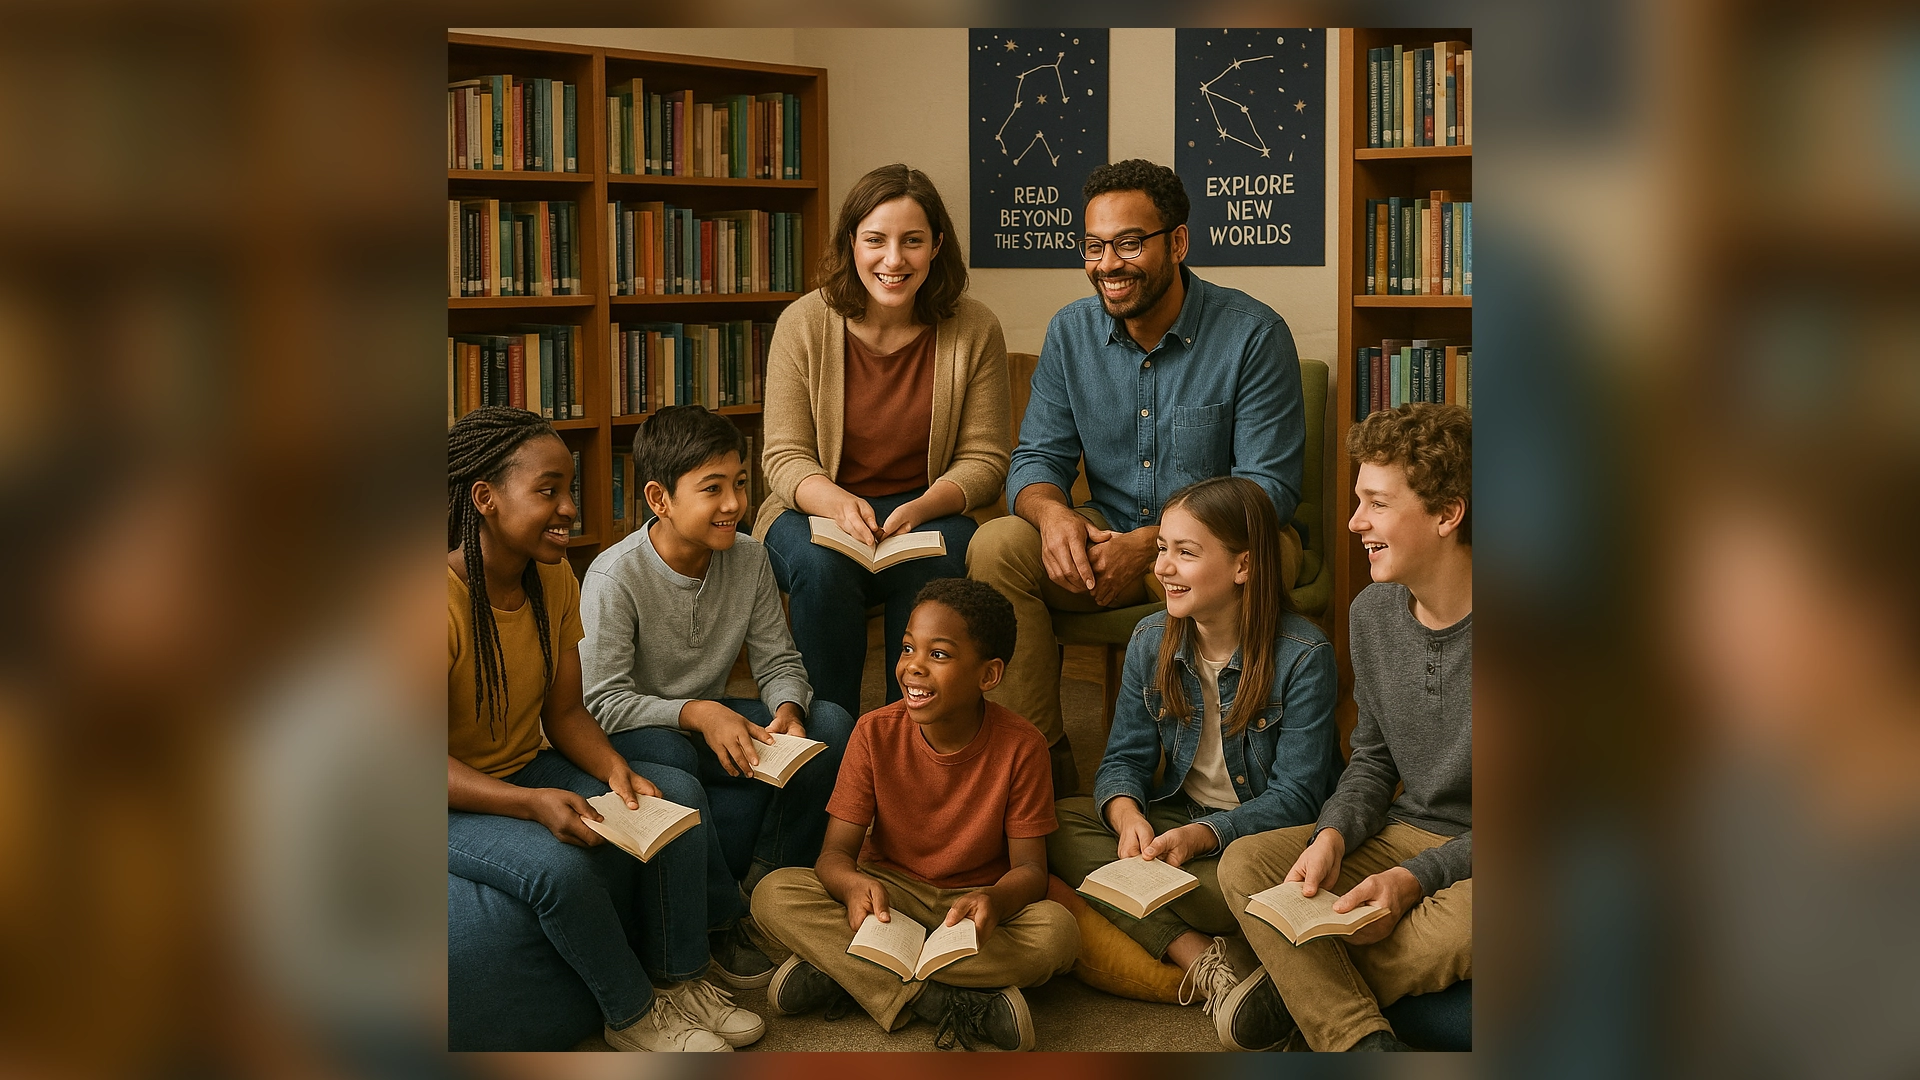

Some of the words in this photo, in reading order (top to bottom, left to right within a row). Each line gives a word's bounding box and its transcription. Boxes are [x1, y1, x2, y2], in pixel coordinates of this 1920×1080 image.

[1014, 186, 1059, 205] READ
[1206, 173, 1295, 197] EXPLORE
[1000, 207, 1073, 227] BEYOND
[1227, 199, 1273, 221] NEW
[994, 233, 1020, 249] THE
[1023, 231, 1076, 250] STARS
[1209, 223, 1292, 246] WORLDS
